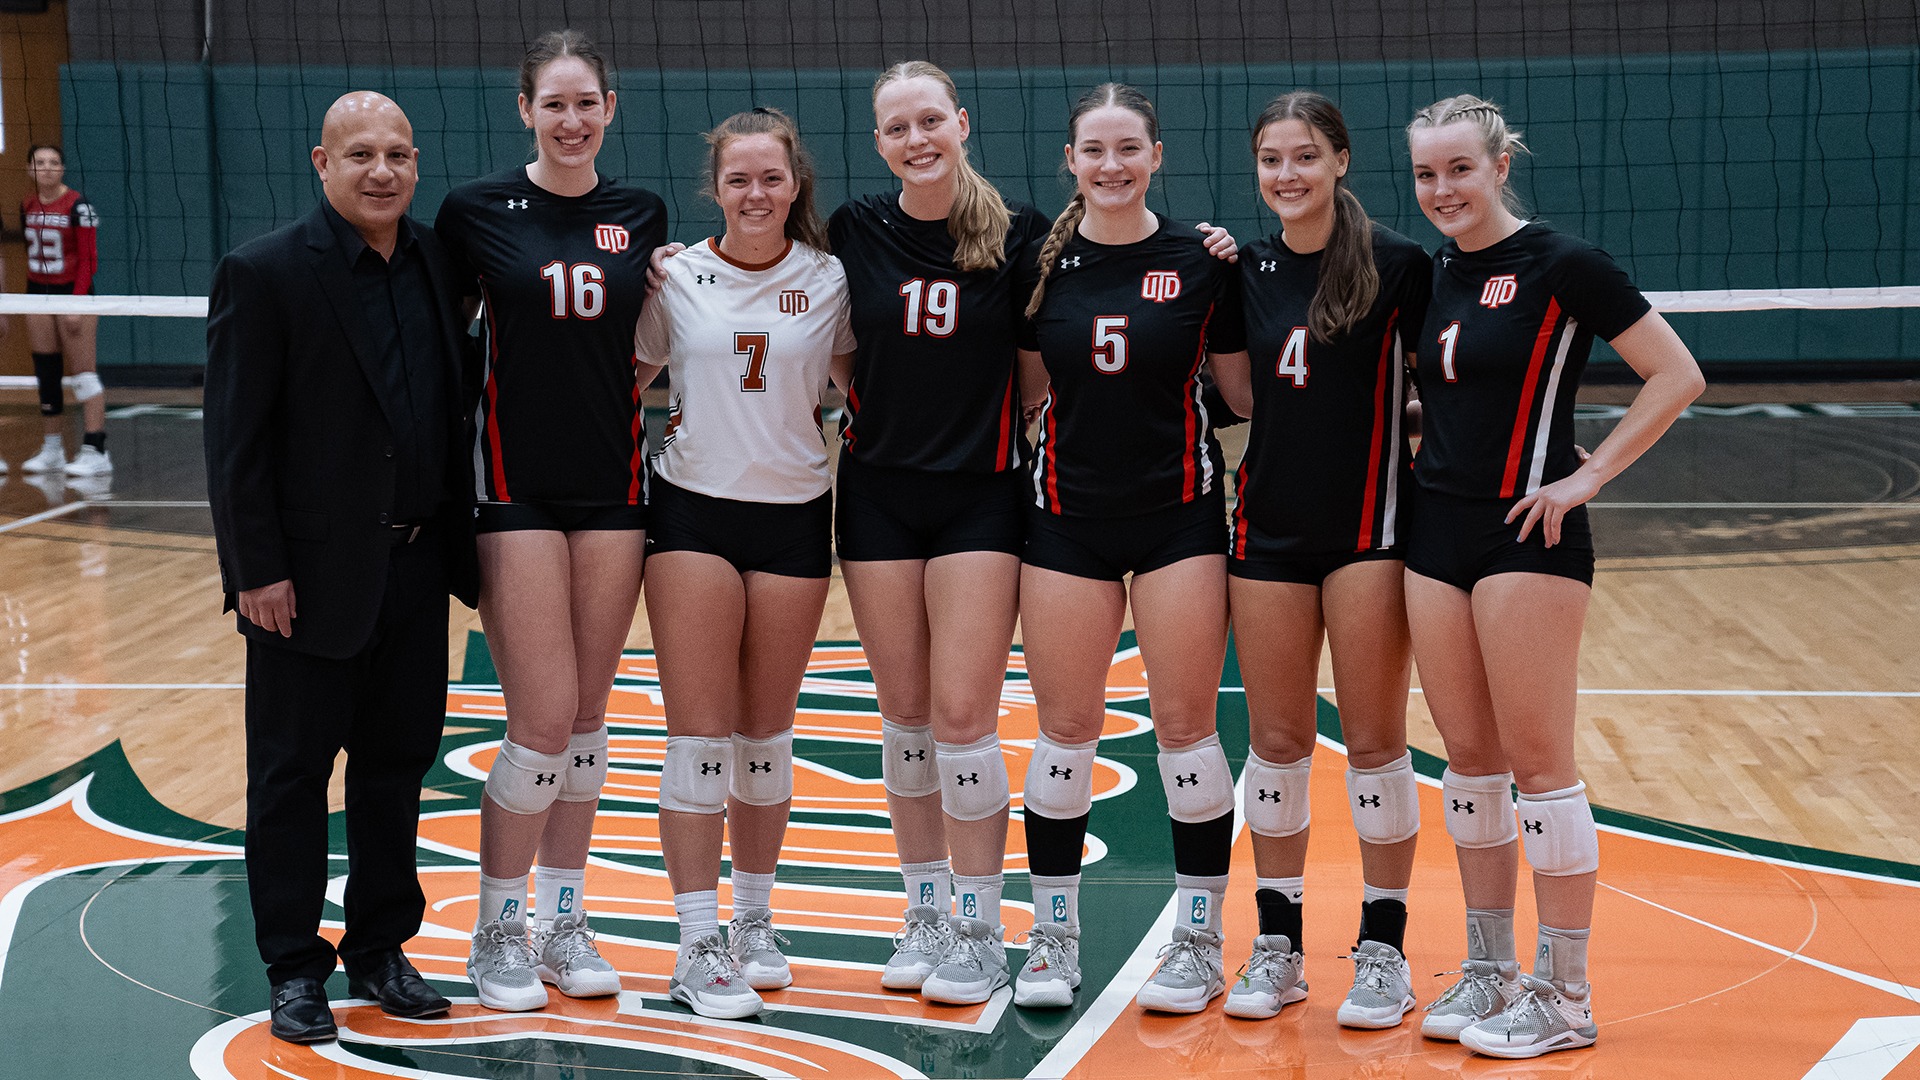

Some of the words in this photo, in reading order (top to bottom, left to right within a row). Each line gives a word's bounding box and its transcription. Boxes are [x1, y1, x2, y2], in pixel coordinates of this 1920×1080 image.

[24, 227, 64, 274] 23
[594, 223, 630, 254] UTD
[540, 260, 607, 320] 16
[779, 289, 810, 316] UTD
[899, 277, 960, 338] 19
[1141, 270, 1182, 302] UTD
[1479, 273, 1519, 309] UTD
[733, 332, 770, 392] 7
[1091, 315, 1129, 375] 5
[1276, 326, 1311, 388] 4
[1438, 320, 1461, 383] 1
